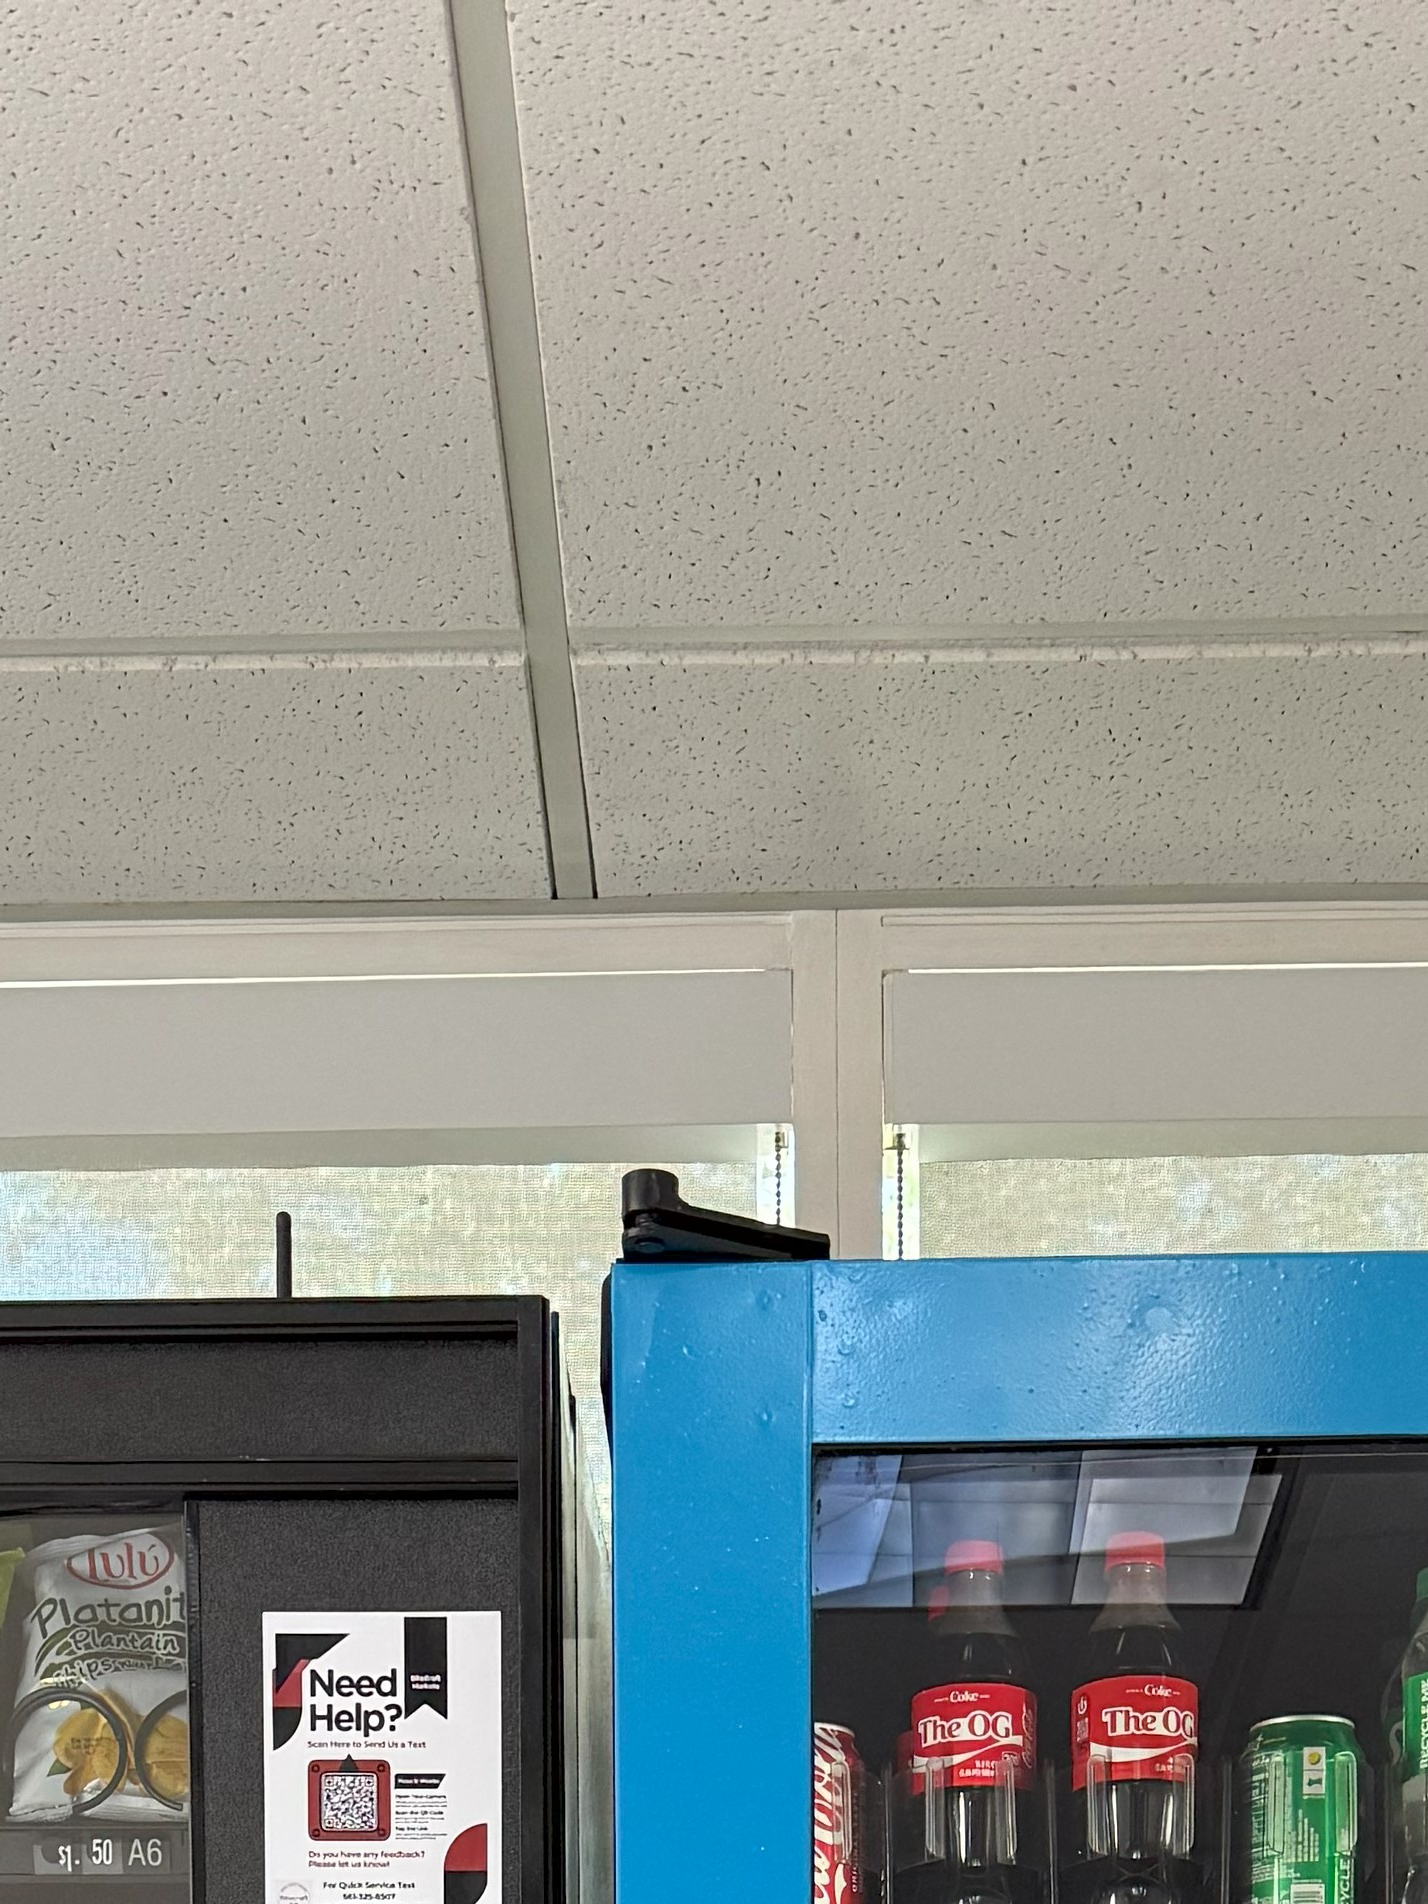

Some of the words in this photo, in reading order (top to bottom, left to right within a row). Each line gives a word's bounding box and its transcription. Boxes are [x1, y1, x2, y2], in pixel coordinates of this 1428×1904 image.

[309, 1668, 398, 1699] Need
[949, 1690, 980, 1704] Coke
[309, 1703, 403, 1738] Help?
[918, 1714, 961, 1747] The
[967, 1710, 1013, 1741] OG
[128, 1839, 162, 1867] A6
